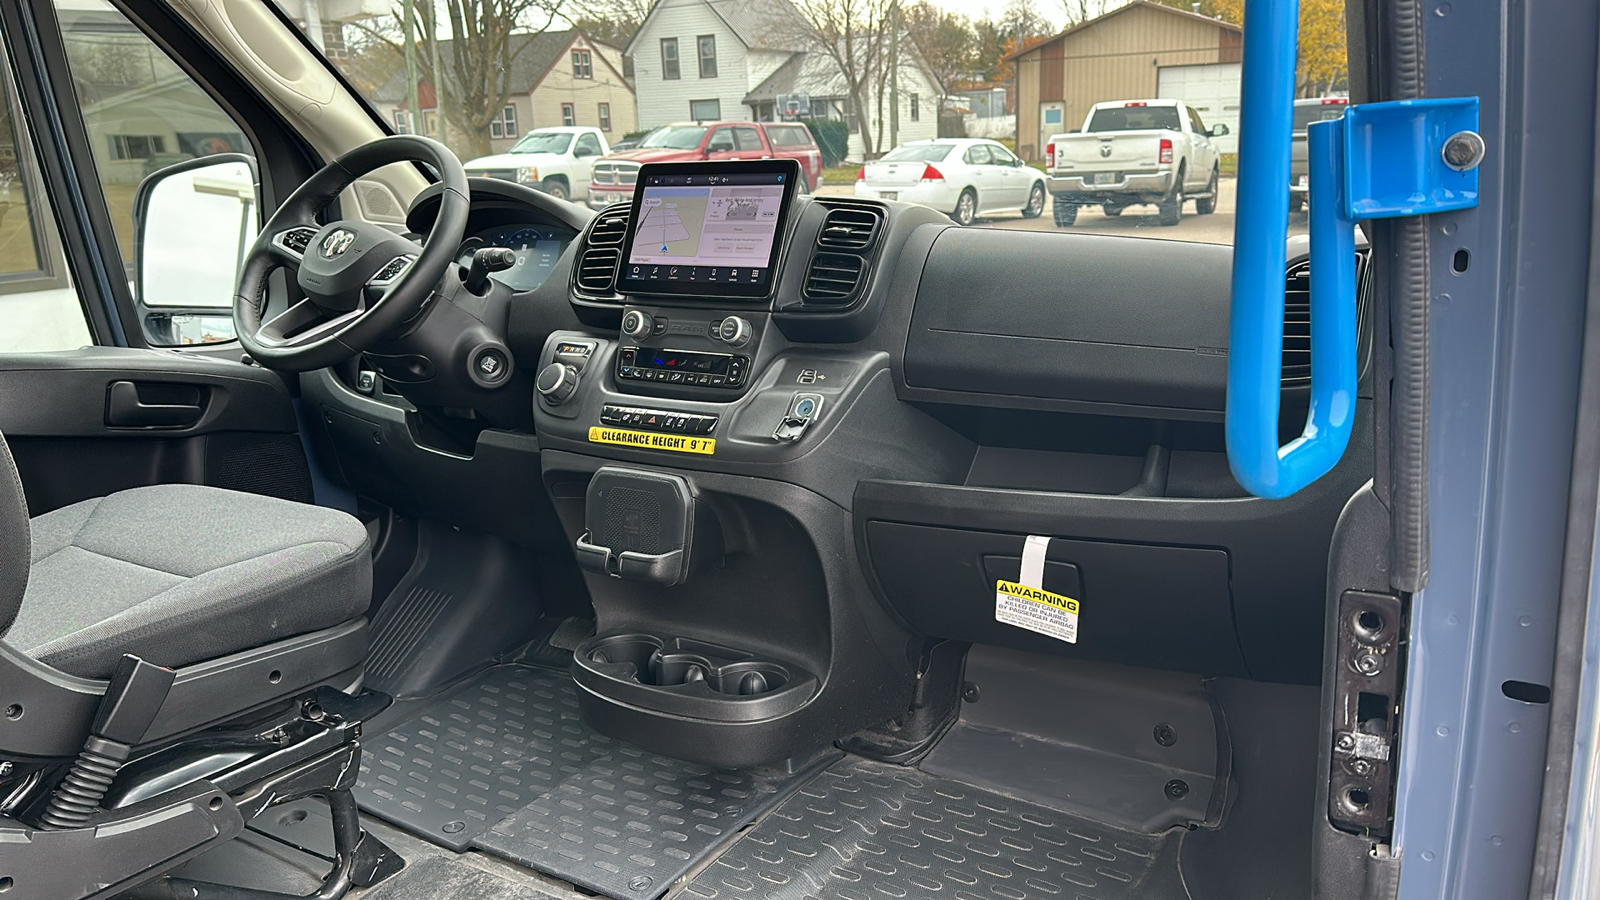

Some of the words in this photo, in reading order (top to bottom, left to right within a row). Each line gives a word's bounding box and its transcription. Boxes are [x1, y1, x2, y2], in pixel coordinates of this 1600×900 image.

[671, 324, 703, 333] RAM
[601, 431, 650, 445] CLEARANCE
[652, 436, 686, 448] HEIGHT
[690, 440, 700, 450] 9'
[1007, 596, 1041, 608] CHILDREN
[1041, 605, 1057, 613] CAN
[1010, 585, 1077, 611] WARNING
[1005, 601, 1027, 610] KILLED
[1039, 609, 1068, 622] INJURED
[1009, 607, 1048, 622] PASSENGER
[1049, 619, 1074, 630] AIRBAG
